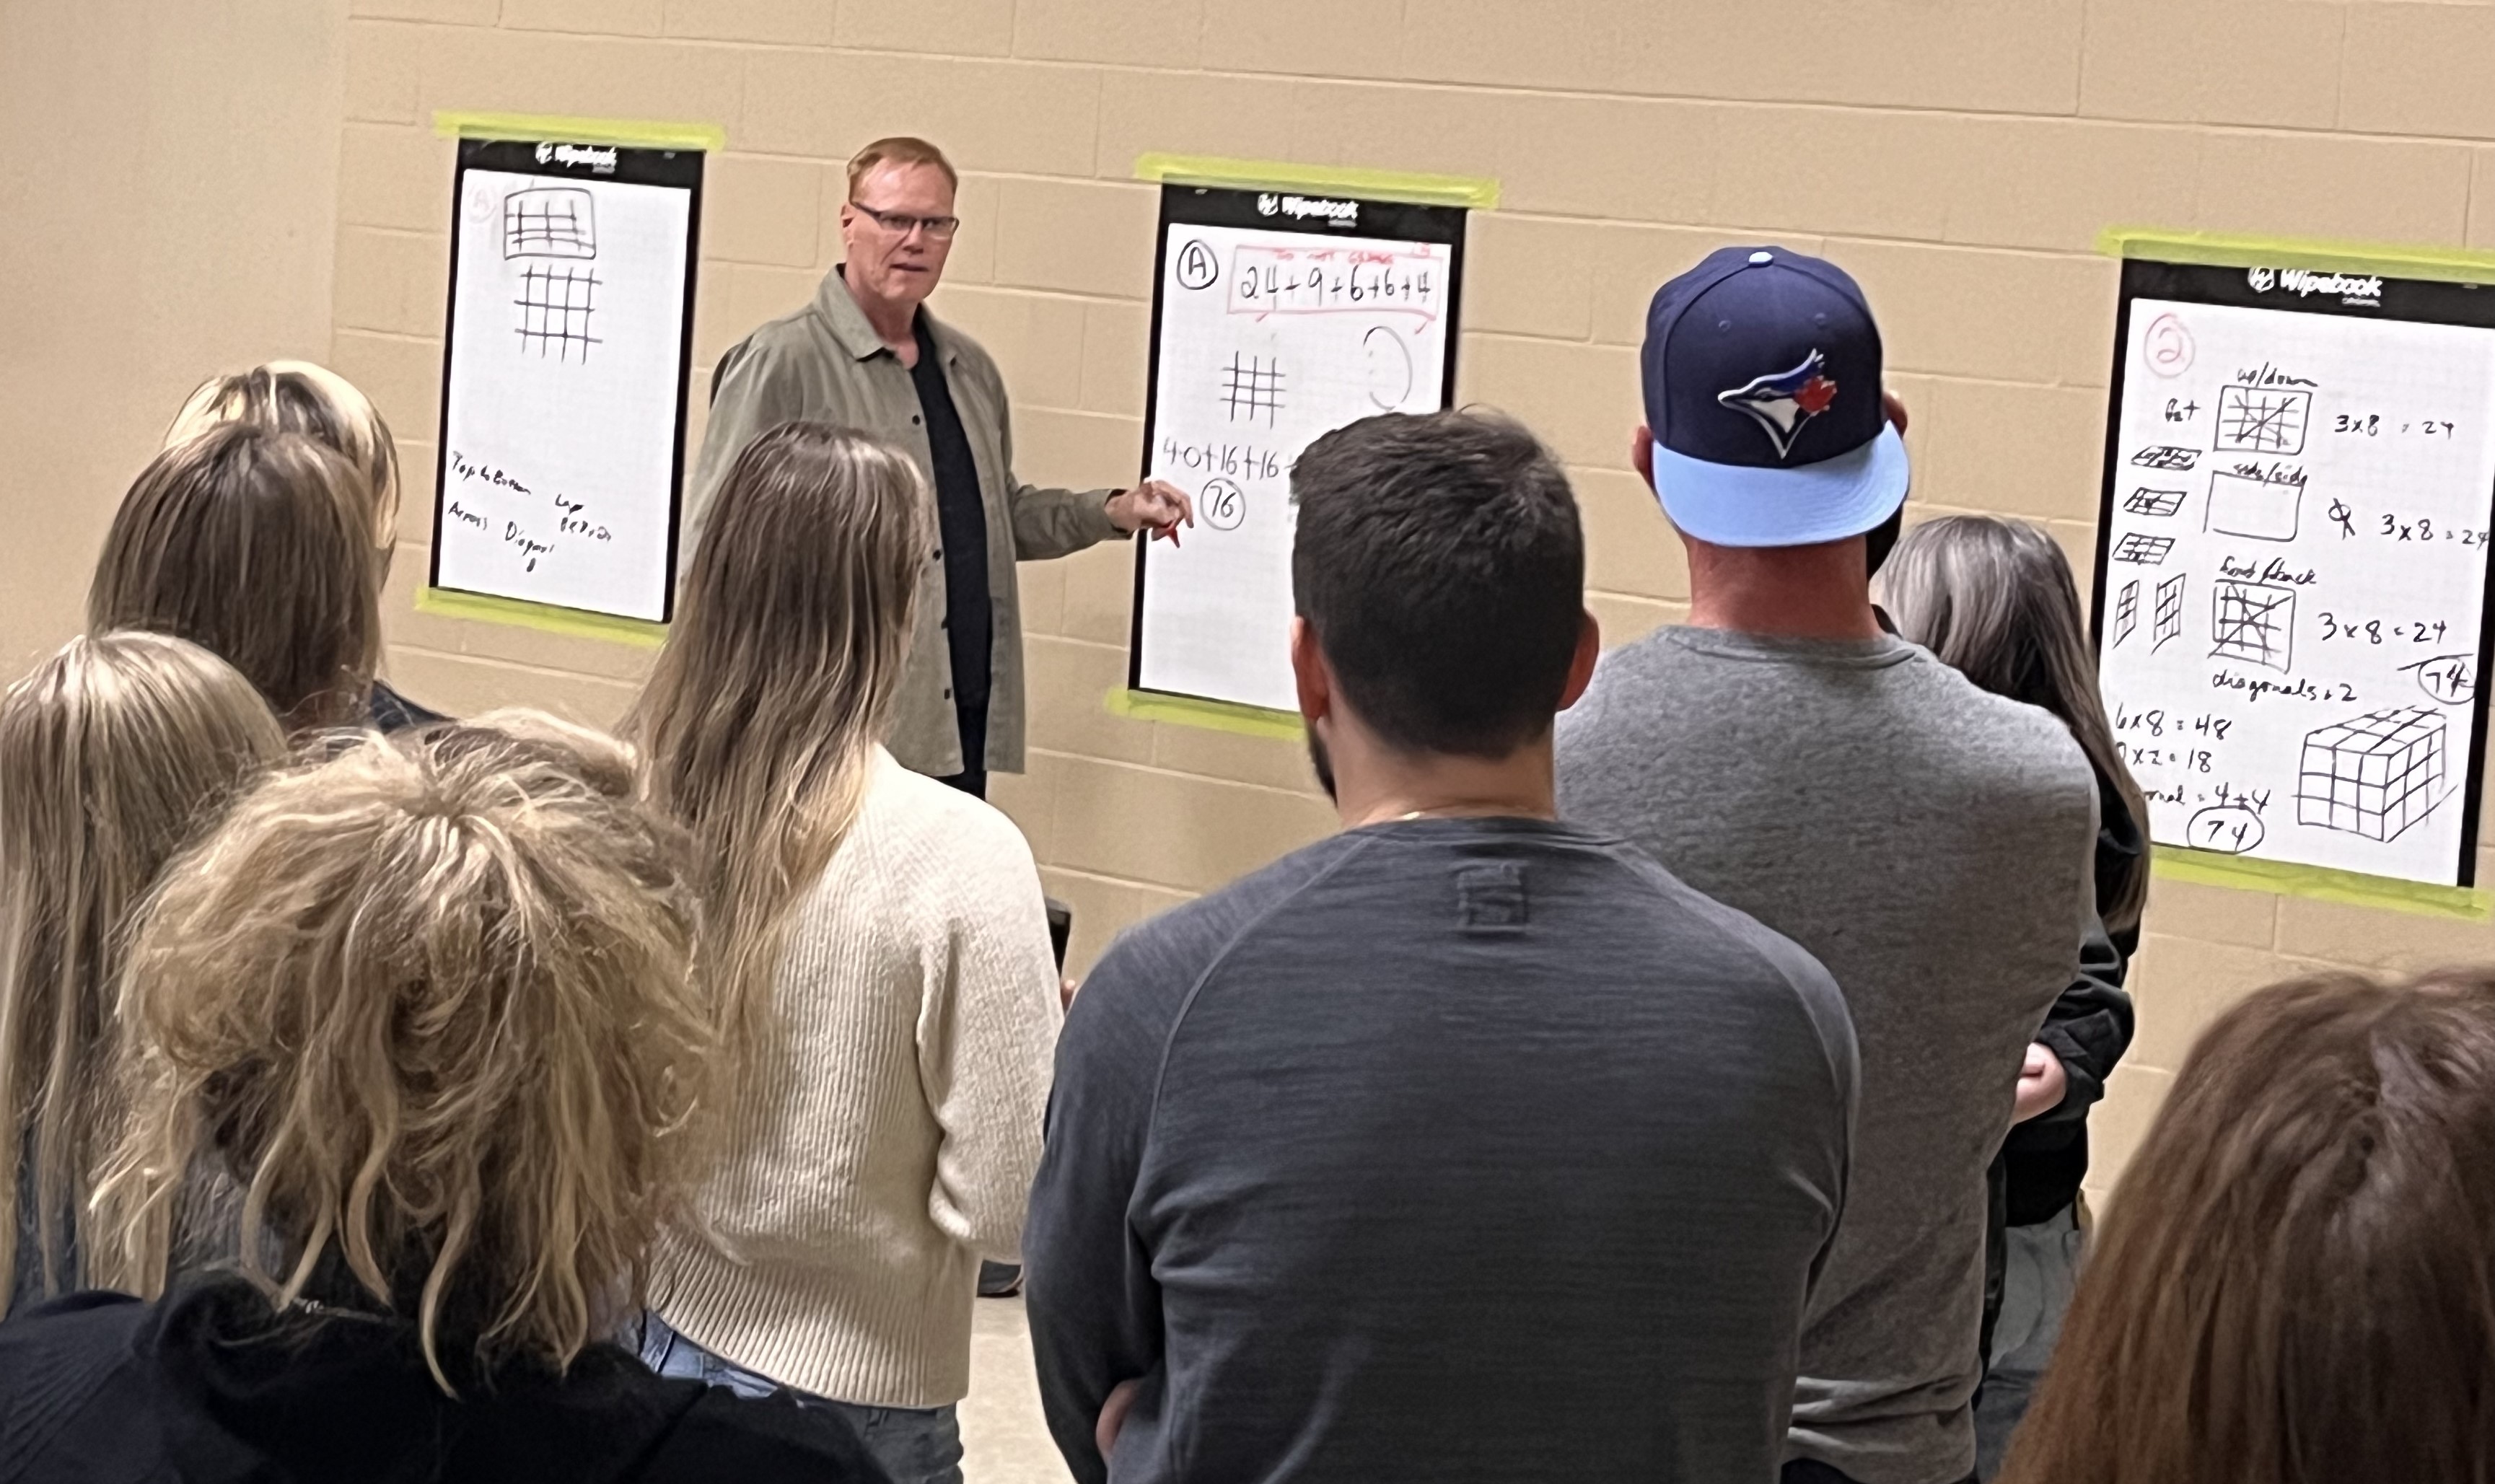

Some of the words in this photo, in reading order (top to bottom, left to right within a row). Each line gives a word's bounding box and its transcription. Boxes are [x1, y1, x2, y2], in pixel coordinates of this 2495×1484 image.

[1188, 246, 1207, 280] A
[1209, 486, 1236, 518] 76
[2196, 714, 2232, 740] 48
[2188, 747, 2212, 773] 18
